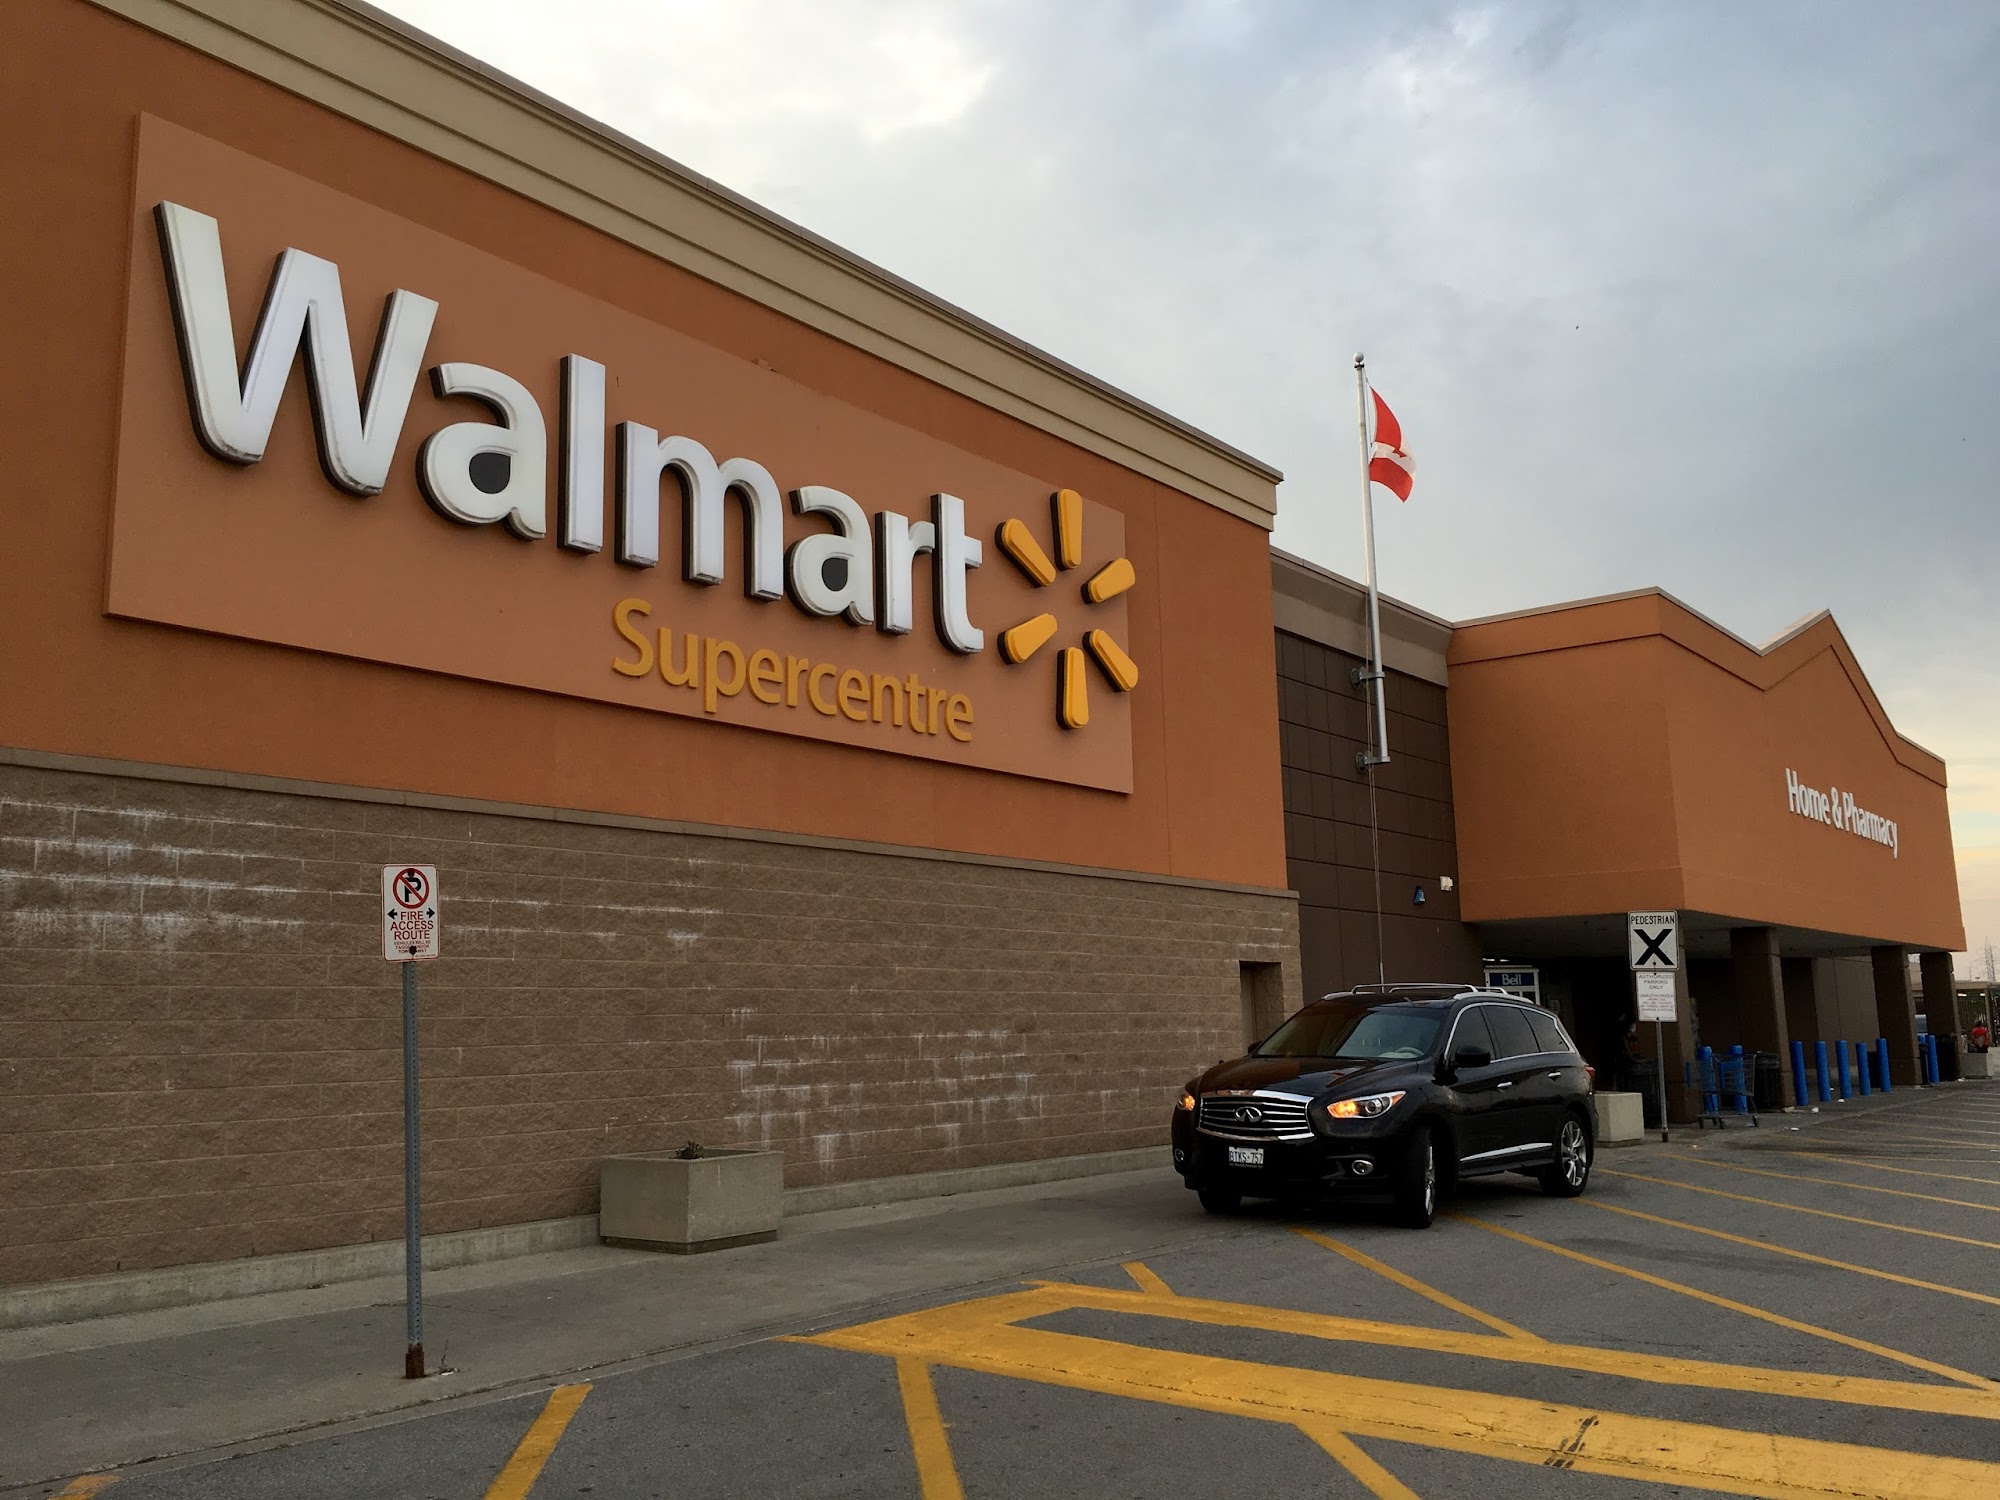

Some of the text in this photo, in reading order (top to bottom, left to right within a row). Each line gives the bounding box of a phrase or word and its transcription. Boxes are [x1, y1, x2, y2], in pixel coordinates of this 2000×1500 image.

[154, 200, 984, 655] Walmart
[612, 598, 975, 742] Supercentre
[1785, 767, 1898, 859] Home & Pharmacy
[400, 911, 424, 920] FIRE
[1631, 915, 1675, 925] PEDESTRIAN
[390, 920, 434, 931] ACCESS
[394, 930, 430, 940] ROUTE
[1502, 973, 1522, 986] Bell
